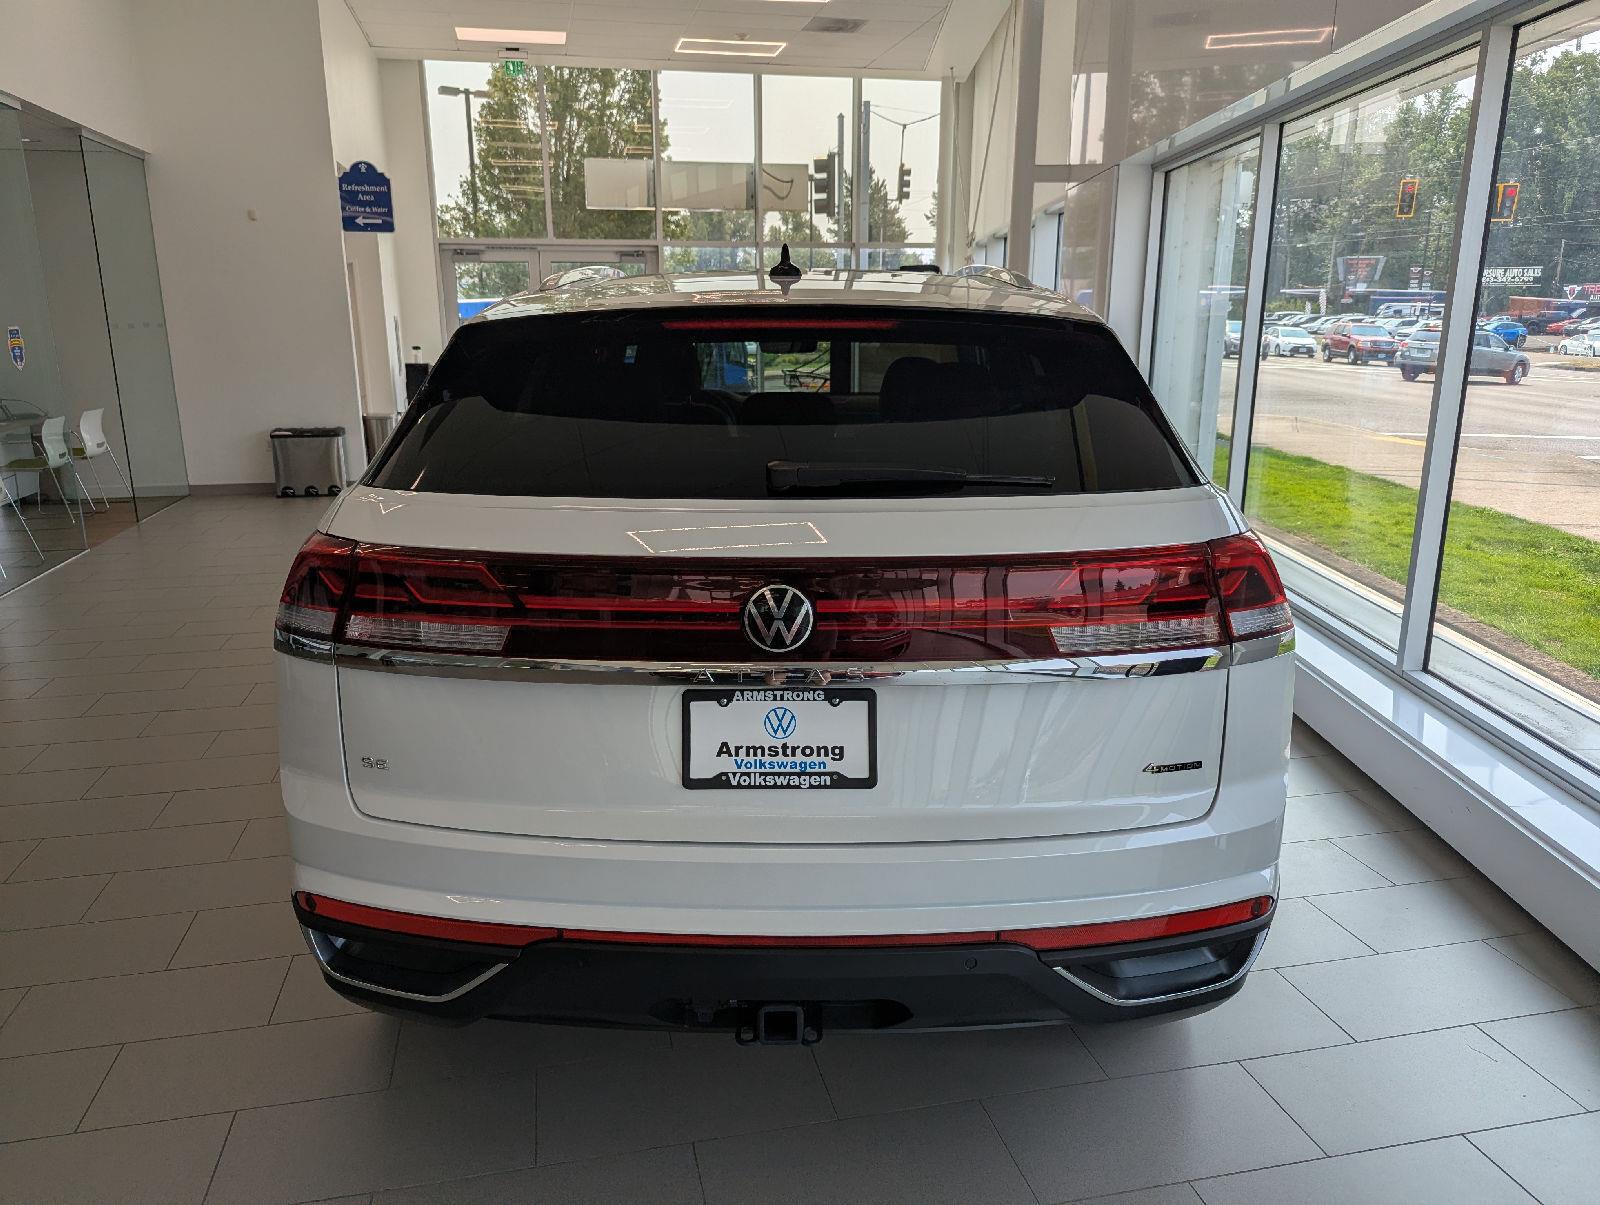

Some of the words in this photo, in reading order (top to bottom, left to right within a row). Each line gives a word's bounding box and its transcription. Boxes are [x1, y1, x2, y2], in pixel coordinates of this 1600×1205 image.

[342, 184, 388, 192] Refreshment
[358, 193, 375, 201] Area
[1505, 268, 1523, 278] AUTO
[1523, 268, 1542, 277] SALES
[692, 667, 865, 684] ATLAS
[732, 690, 825, 701] ARMSTRONG
[716, 741, 845, 762] Armstrong
[733, 758, 827, 772] Volkswagen
[728, 772, 831, 788] Volkswagen
